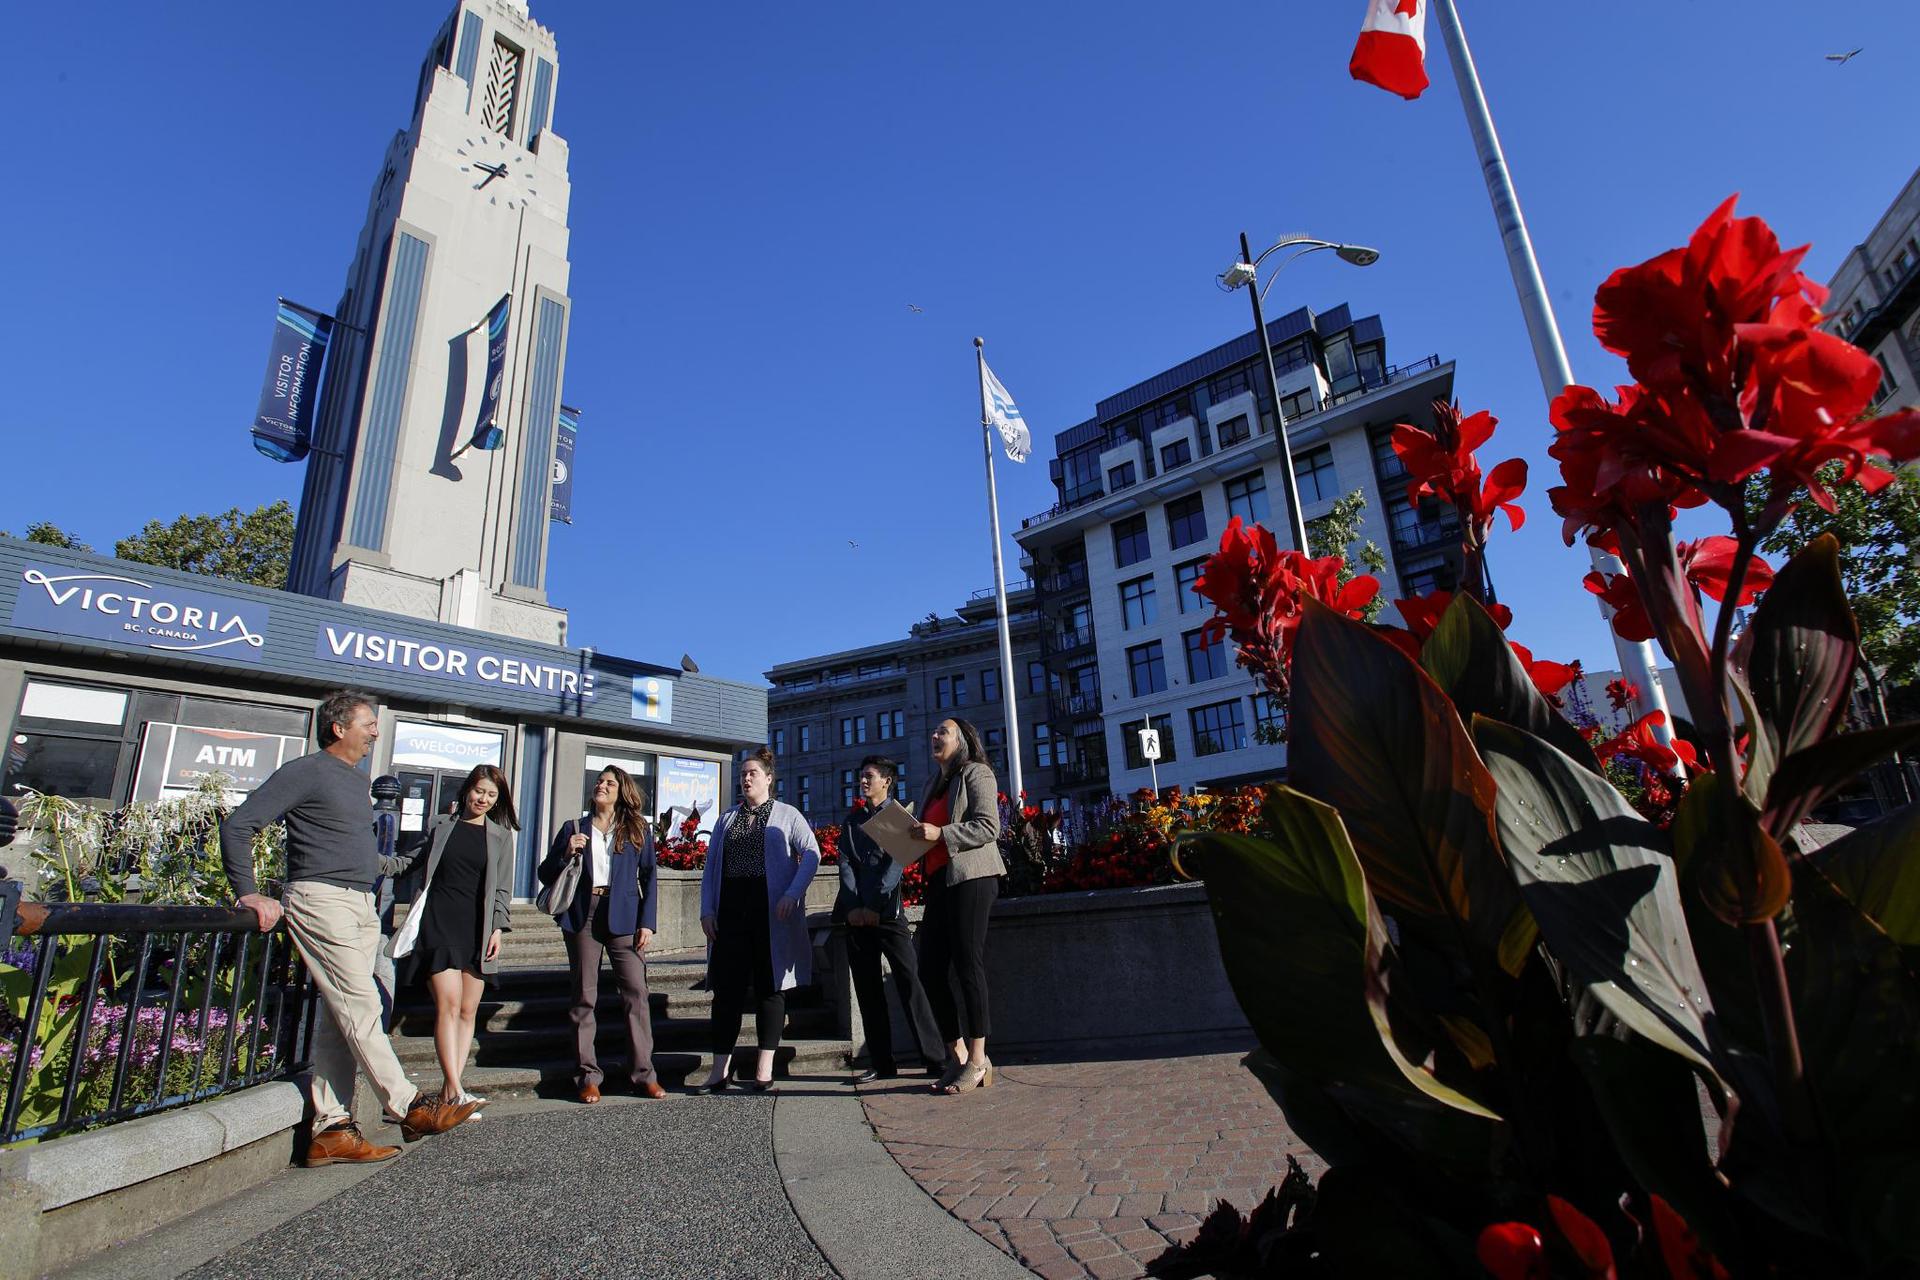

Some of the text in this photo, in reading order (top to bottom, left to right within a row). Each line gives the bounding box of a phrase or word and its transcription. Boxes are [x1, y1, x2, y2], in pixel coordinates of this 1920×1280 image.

[274, 355, 294, 398] VISITOR
[288, 342, 312, 420] INFORMATION
[26, 569, 263, 646] VICTORIA
[148, 626, 198, 641] CANADA
[326, 627, 595, 697] VISITOR CENTRE
[195, 744, 257, 768] ATM
[411, 738, 489, 757] WELCOME
